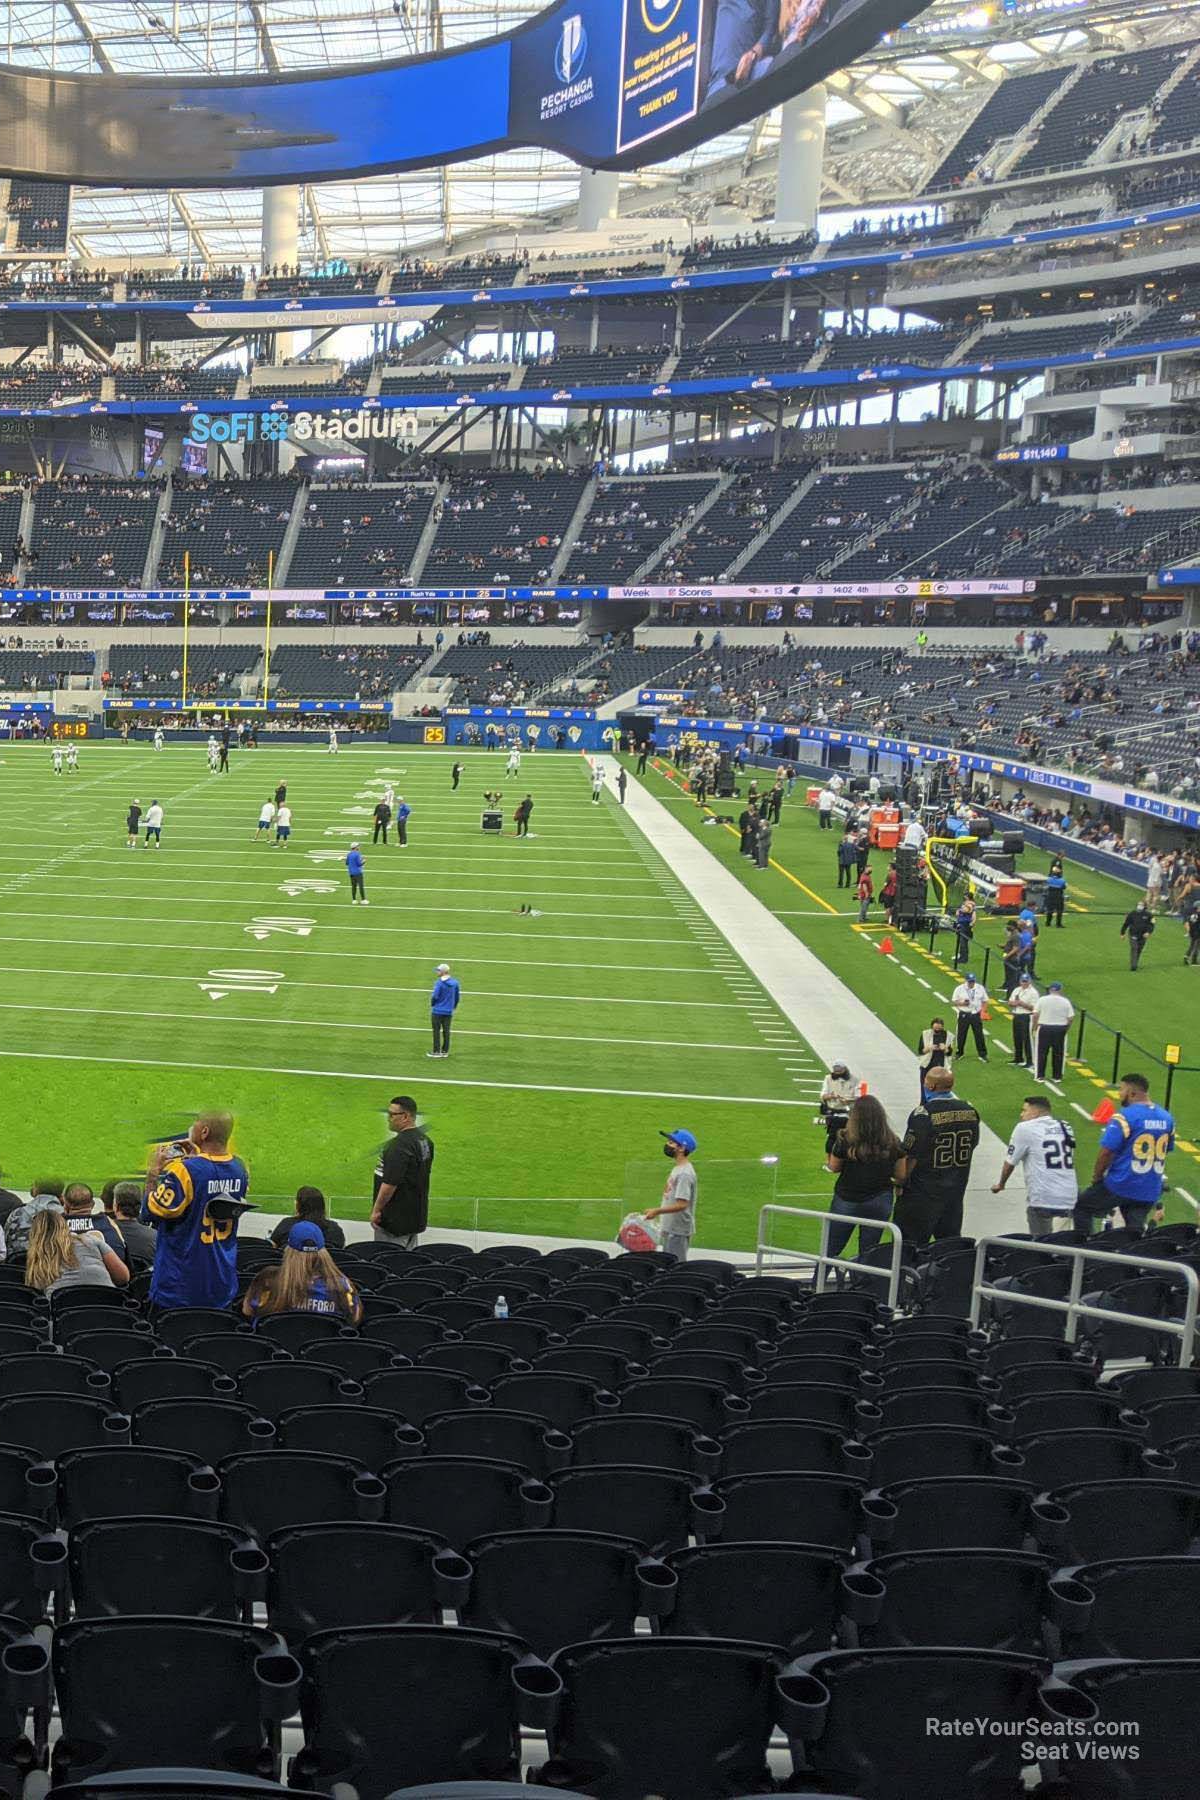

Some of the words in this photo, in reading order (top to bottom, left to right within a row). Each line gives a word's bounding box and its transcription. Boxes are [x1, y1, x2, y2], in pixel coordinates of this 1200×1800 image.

[540, 76, 593, 112] PECHANGA
[639, 97, 662, 118] THANK
[662, 88, 678, 106] YOU
[540, 103, 567, 121] RESORT
[191, 412, 254, 442] SoFi
[293, 410, 419, 440] Stadium
[623, 588, 650, 597] Week
[678, 587, 713, 597] Scores
[919, 584, 931, 592] 23
[988, 583, 1009, 591] FINAL
[426, 728, 443, 741] 25
[680, 731, 698, 739] LOS
[243, 916, 318, 936] 20
[199, 968, 286, 995] 10
[933, 1129, 973, 1169] 26
[1043, 1139, 1074, 1170] 28
[1131, 1133, 1169, 1174] 99
[154, 1183, 176, 1208] 99
[208, 1178, 241, 1194] DONALD
[67, 1217, 94, 1231] CORREA
